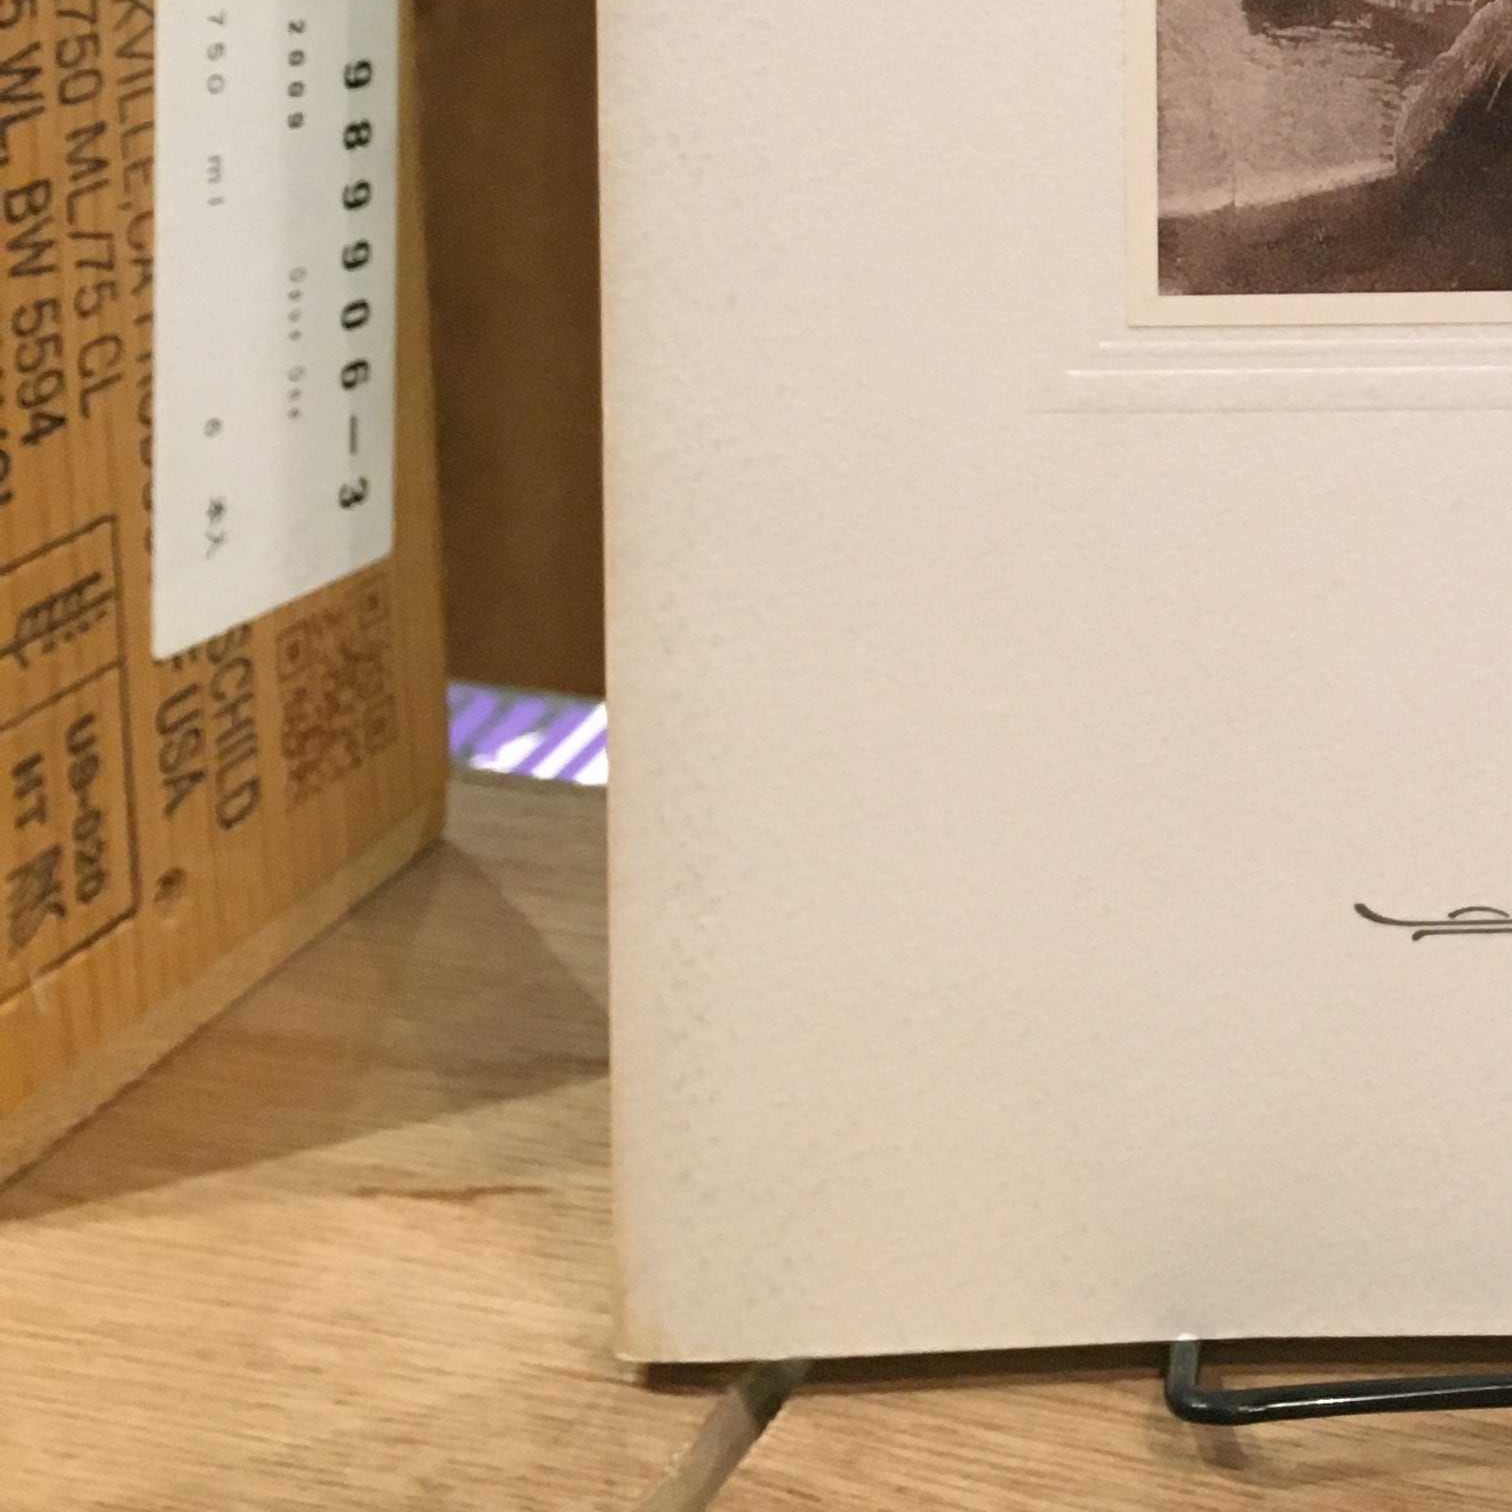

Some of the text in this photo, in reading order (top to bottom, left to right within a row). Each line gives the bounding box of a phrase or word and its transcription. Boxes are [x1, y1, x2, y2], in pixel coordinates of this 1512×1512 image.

[4, 178, 58, 277] BW
[64, 118, 118, 318] ML/75
[11, 297, 67, 447] 5594
[77, 334, 124, 419] CL
[155, 683, 206, 820] USA
